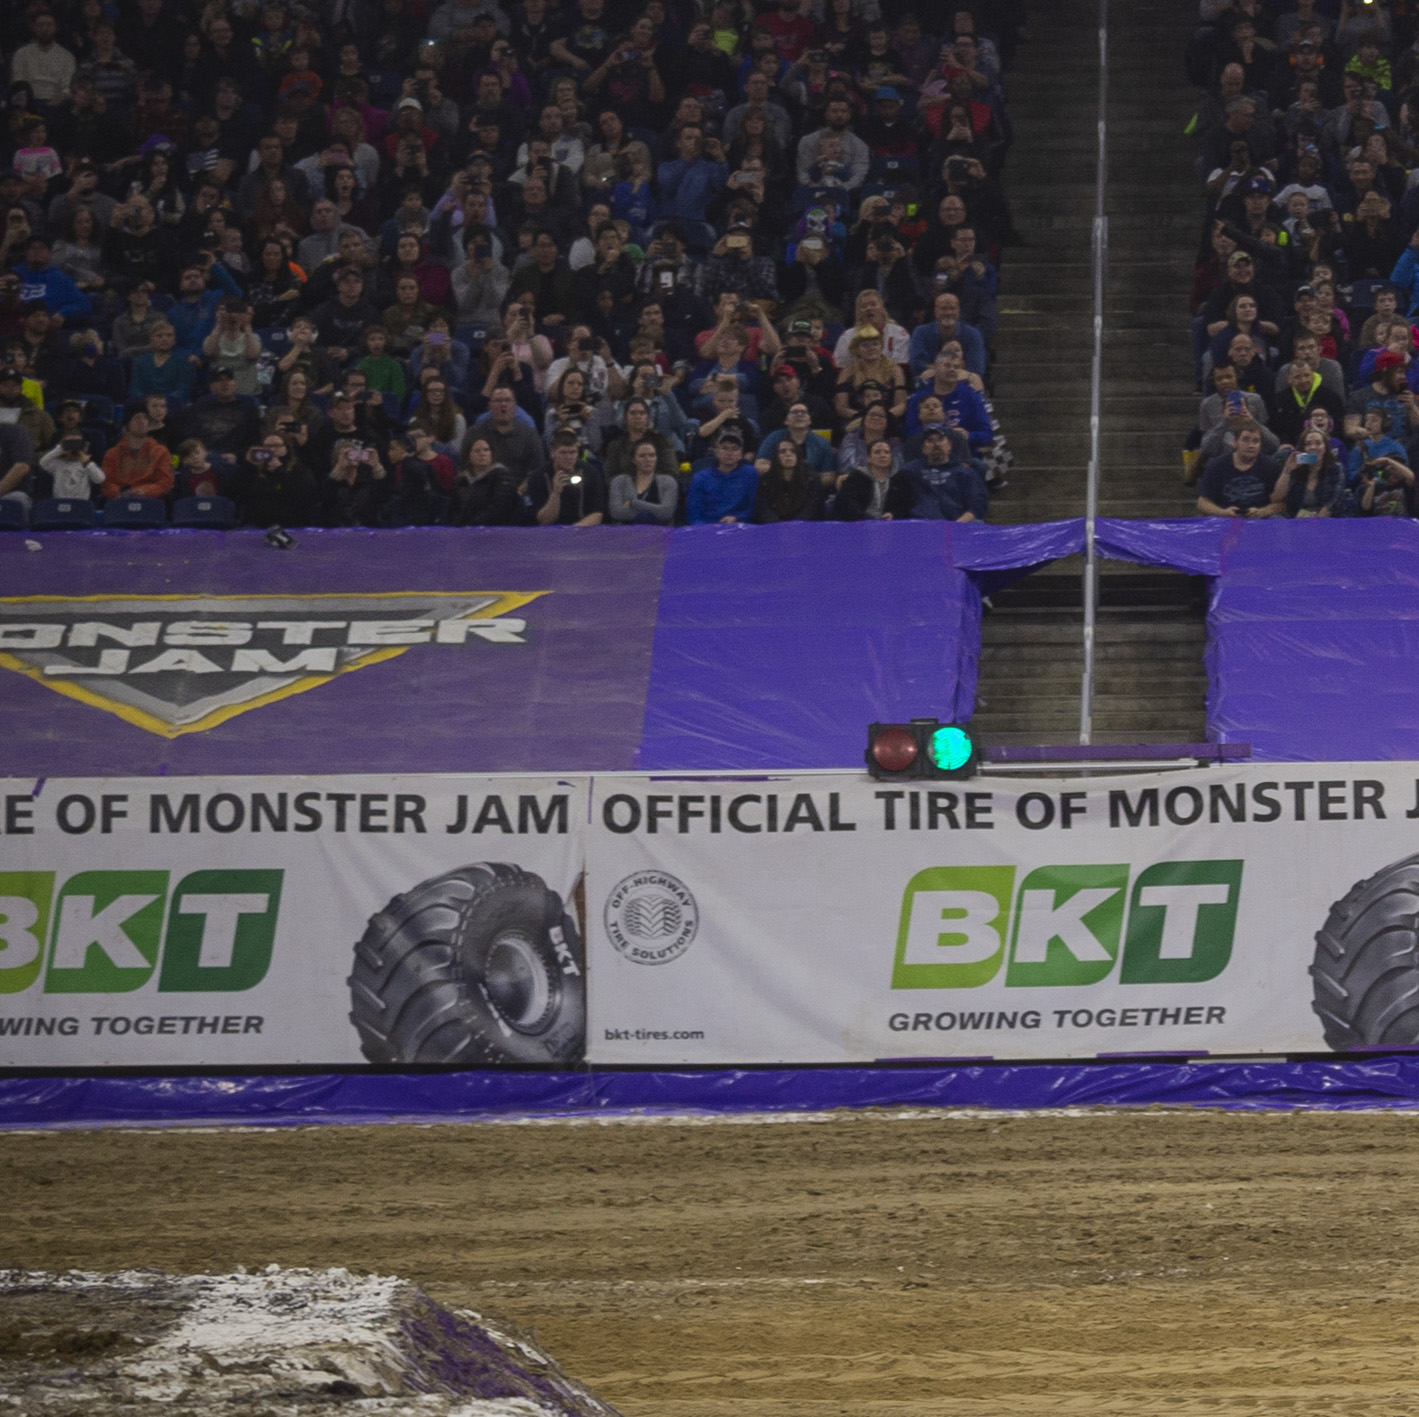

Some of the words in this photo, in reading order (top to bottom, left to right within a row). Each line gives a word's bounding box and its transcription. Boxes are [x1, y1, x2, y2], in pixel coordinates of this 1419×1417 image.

[43, 646, 339, 676] JAM
[0, 794, 36, 836] E
[55, 792, 130, 835] OF
[148, 790, 429, 836] MONSTER
[445, 793, 571, 835] JAM
[602, 791, 857, 836] OFFICIAL
[874, 789, 996, 831] TIRE
[1014, 790, 1089, 831] OF
[1108, 779, 1388, 830] MONSTER
[611, 875, 692, 909] OFF-HIGHWAY
[631, 919, 694, 960] SOLUTIONS
[903, 883, 1231, 966] BKT
[547, 924, 581, 978] BKT
[90, 1014, 266, 1037] TOGETHER
[603, 1025, 706, 1043] bkt-tires.com
[887, 1010, 1043, 1033] GROWING
[1054, 1005, 1228, 1031] TOGETHER
